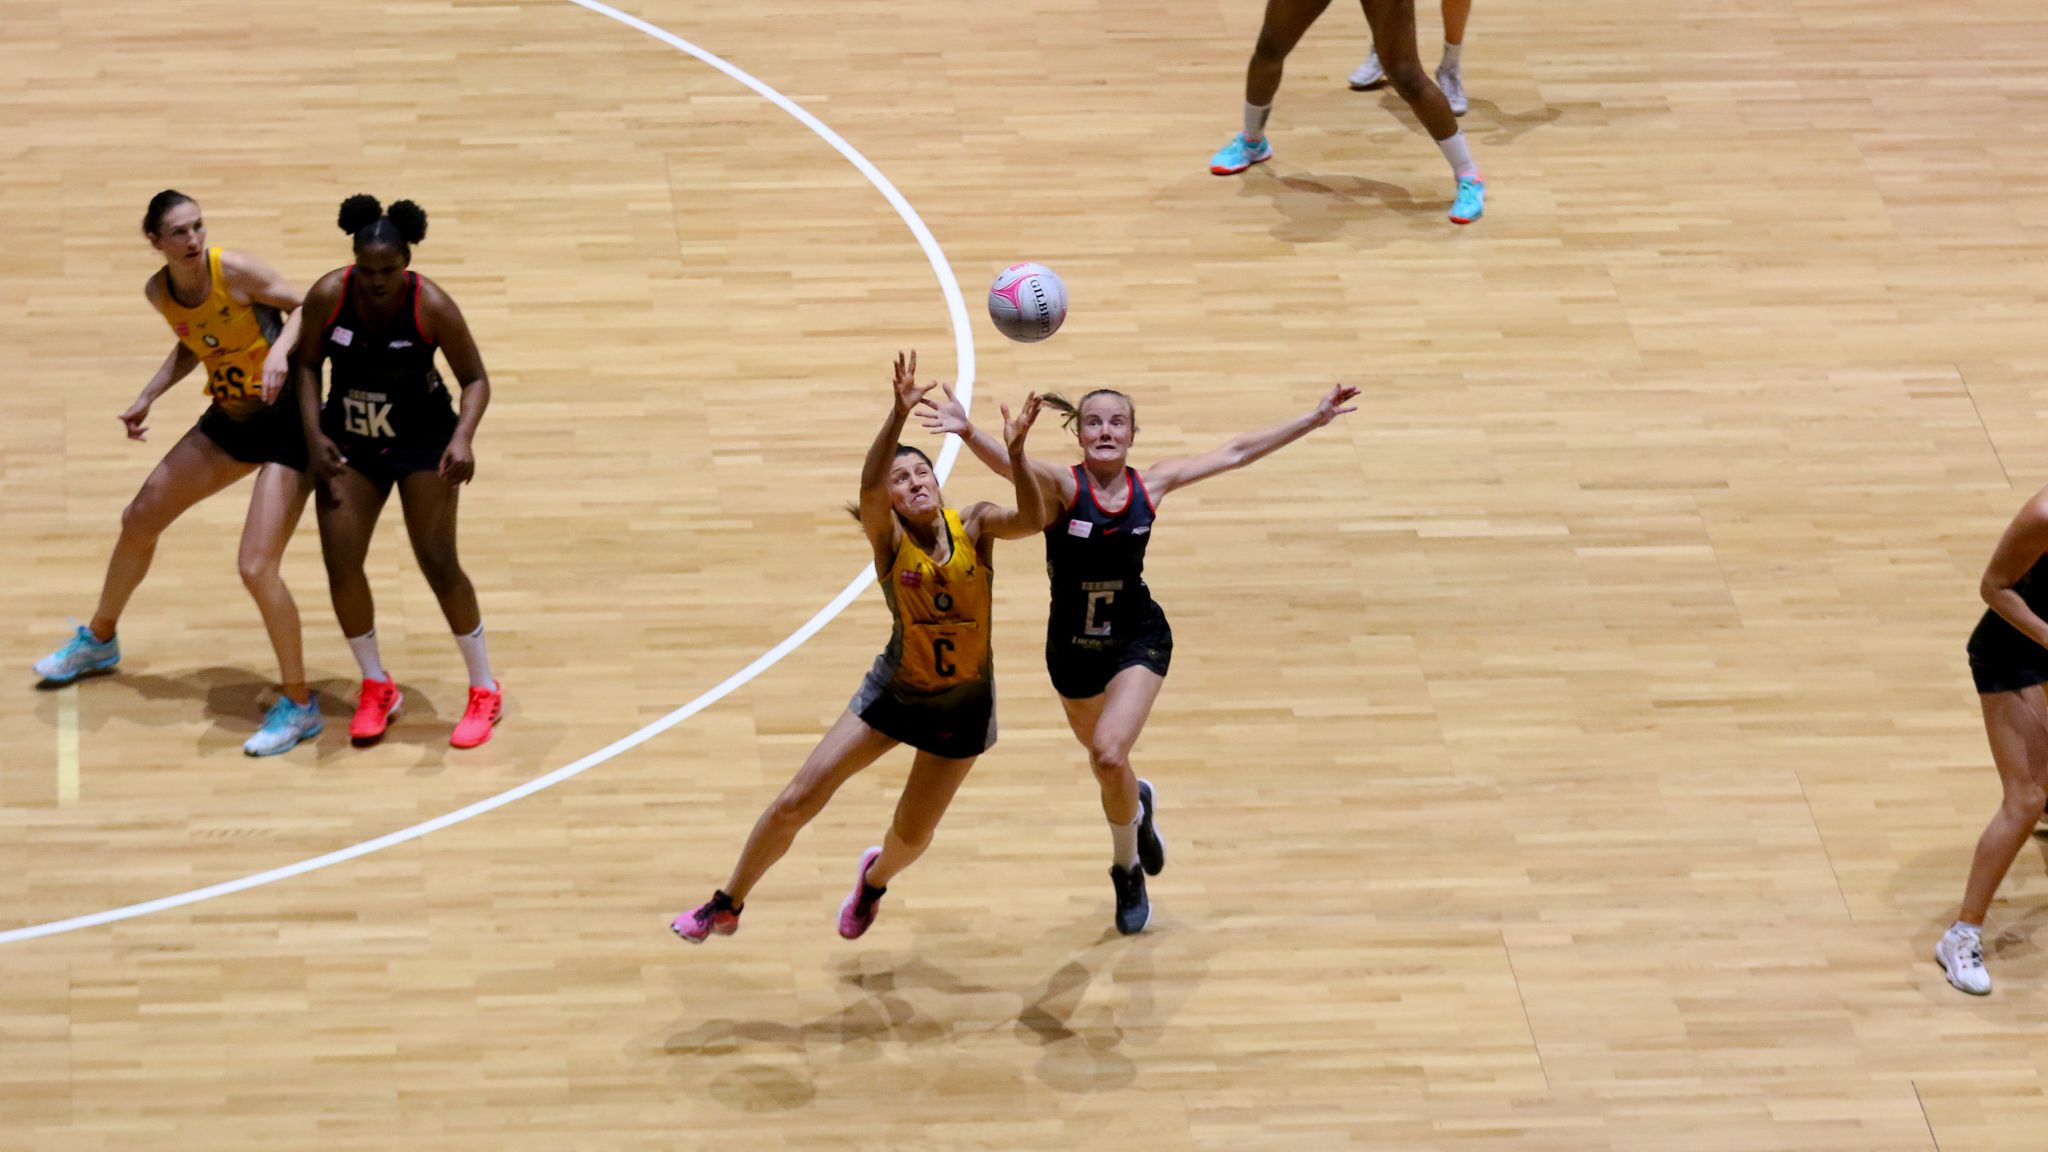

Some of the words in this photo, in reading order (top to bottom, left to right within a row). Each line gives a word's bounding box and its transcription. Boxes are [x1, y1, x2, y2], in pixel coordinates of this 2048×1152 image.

[342, 397, 397, 438] GK
[1084, 591, 1114, 636] C
[933, 639, 956, 677] C
